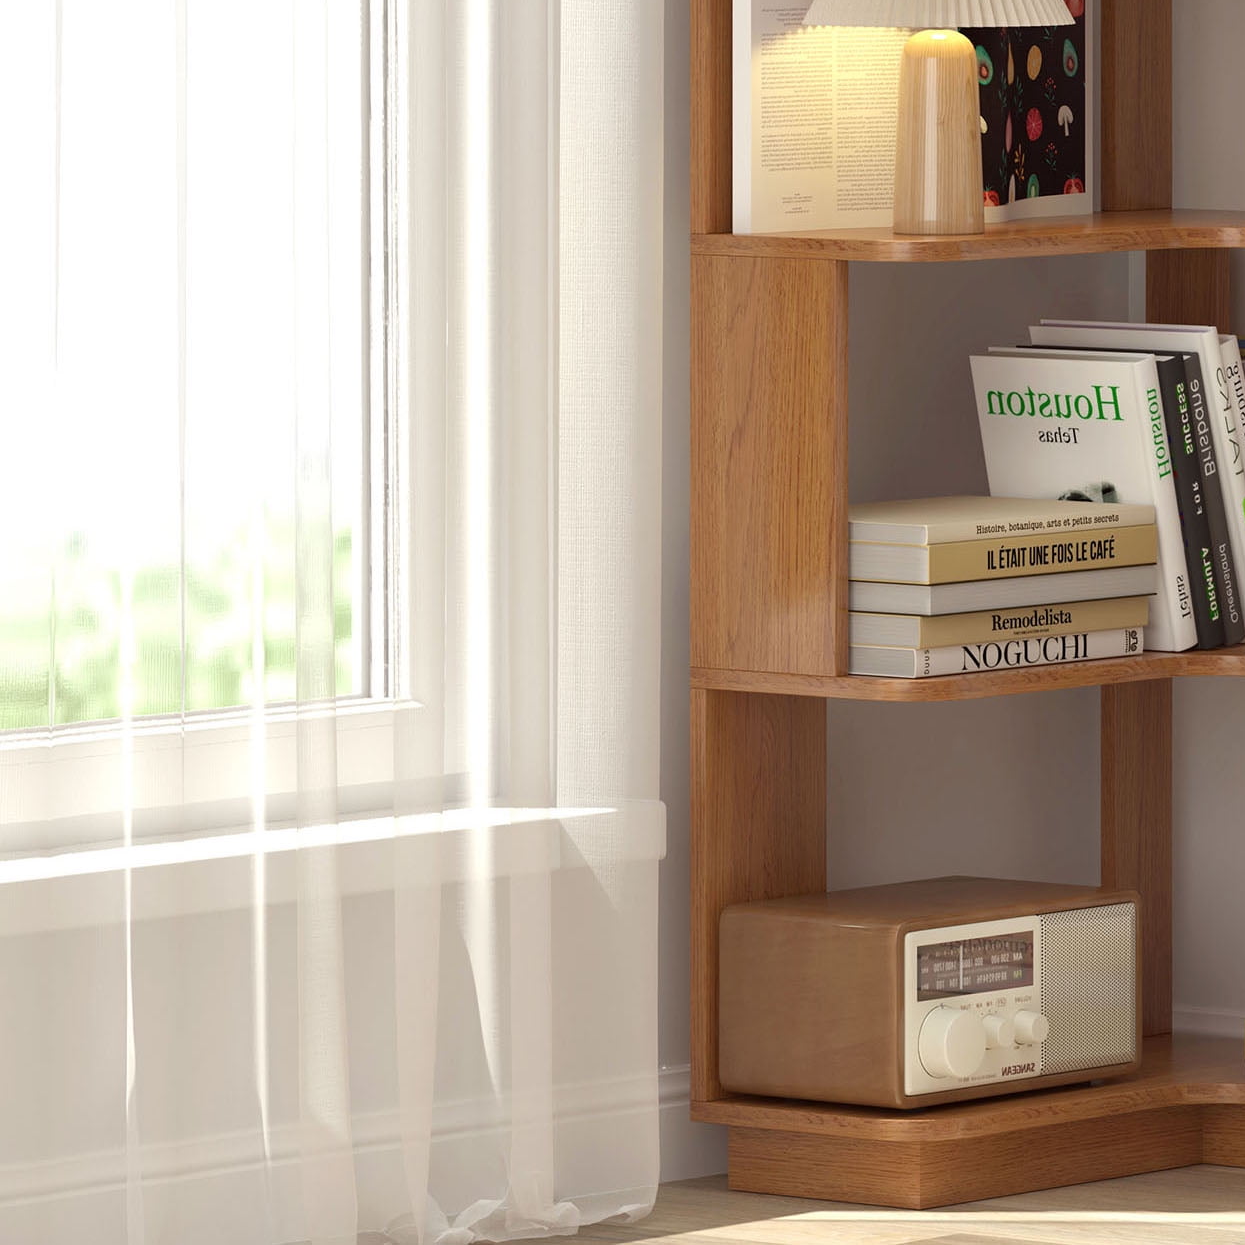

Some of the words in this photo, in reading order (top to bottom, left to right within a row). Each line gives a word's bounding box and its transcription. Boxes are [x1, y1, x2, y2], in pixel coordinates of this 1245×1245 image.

[976, 522, 1008, 535] Histoire,
[1009, 519, 1045, 533] botanique,
[1047, 517, 1062, 528] arts
[1063, 516, 1071, 526] et
[1072, 514, 1092, 527] petits
[1094, 513, 1119, 524] secrets
[987, 550, 997, 570] IL
[999, 545, 1026, 569] ÉTAIT
[1030, 546, 1049, 566] UNE
[1052, 543, 1074, 564] FOIS
[1076, 542, 1088, 561] LE
[1090, 535, 1115, 561] CAFÉ
[992, 608, 1072, 631] Remodelista
[962, 633, 1089, 671] NOGUCHI
